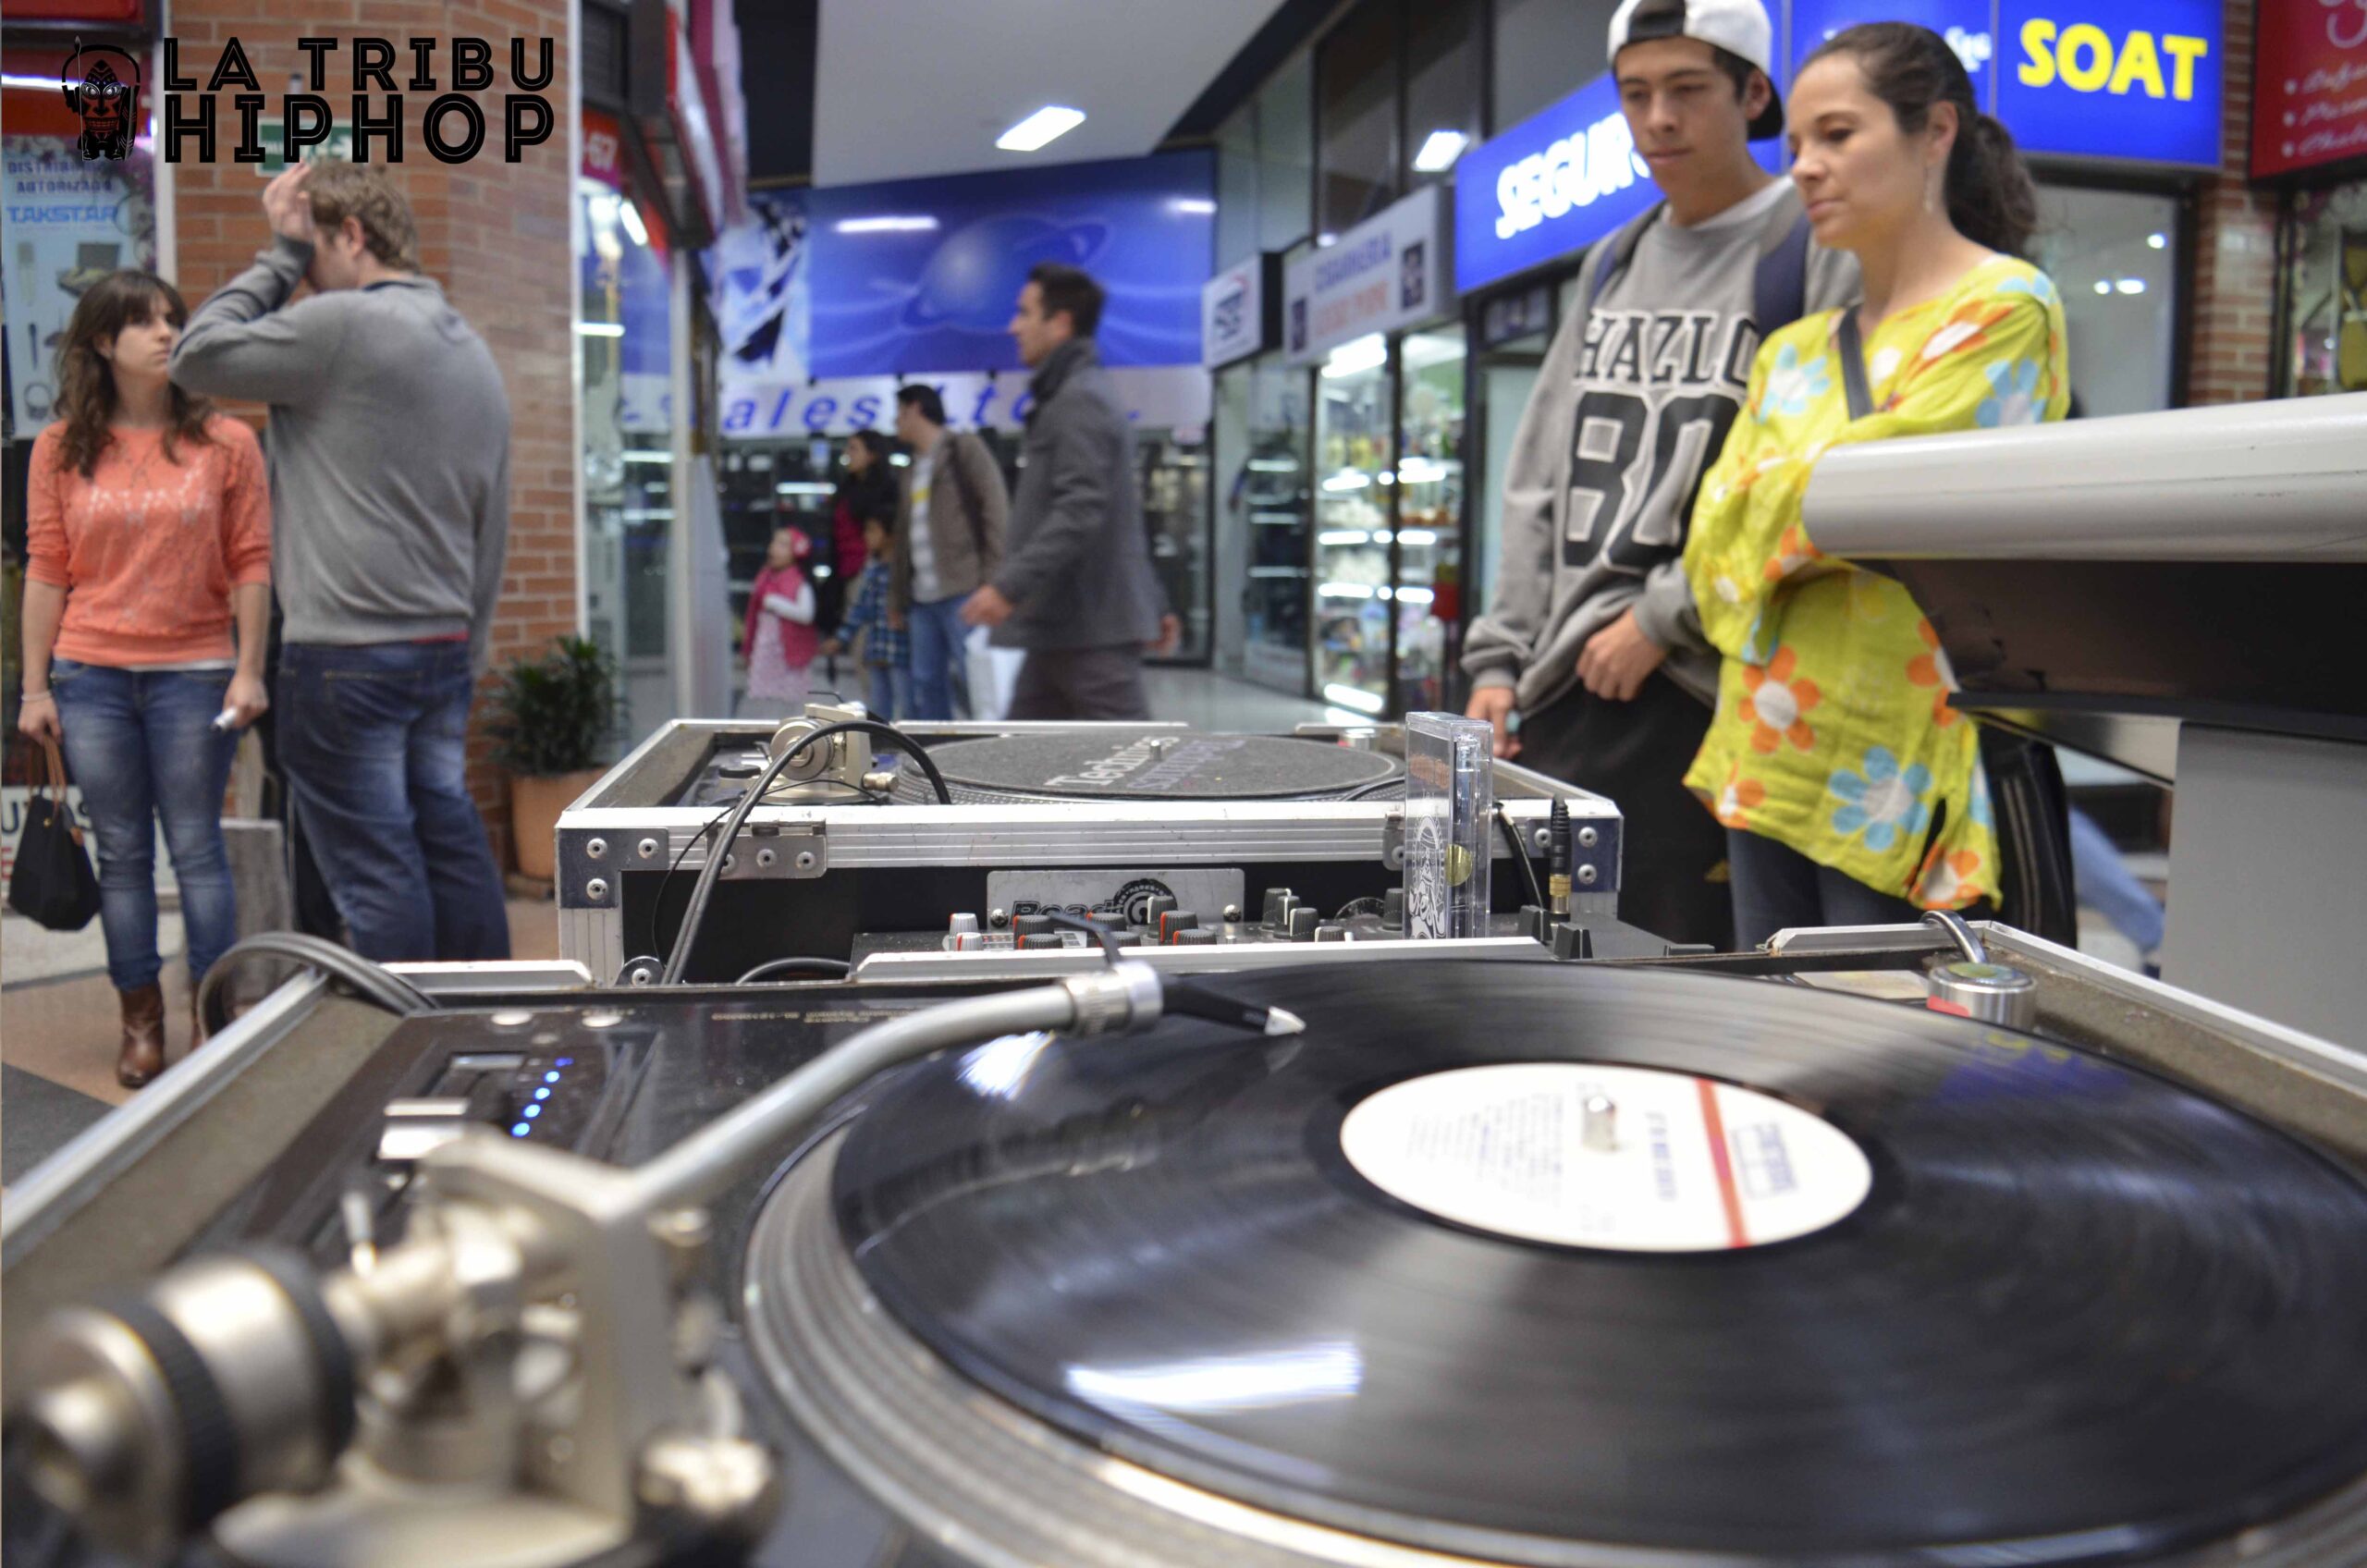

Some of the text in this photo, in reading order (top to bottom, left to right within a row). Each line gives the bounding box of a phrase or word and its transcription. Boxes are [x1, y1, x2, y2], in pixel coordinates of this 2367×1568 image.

[2017, 18, 2207, 102] SOAT
[6, 204, 118, 223] TAKSTAR
[1495, 111, 1651, 239] SEGUR
